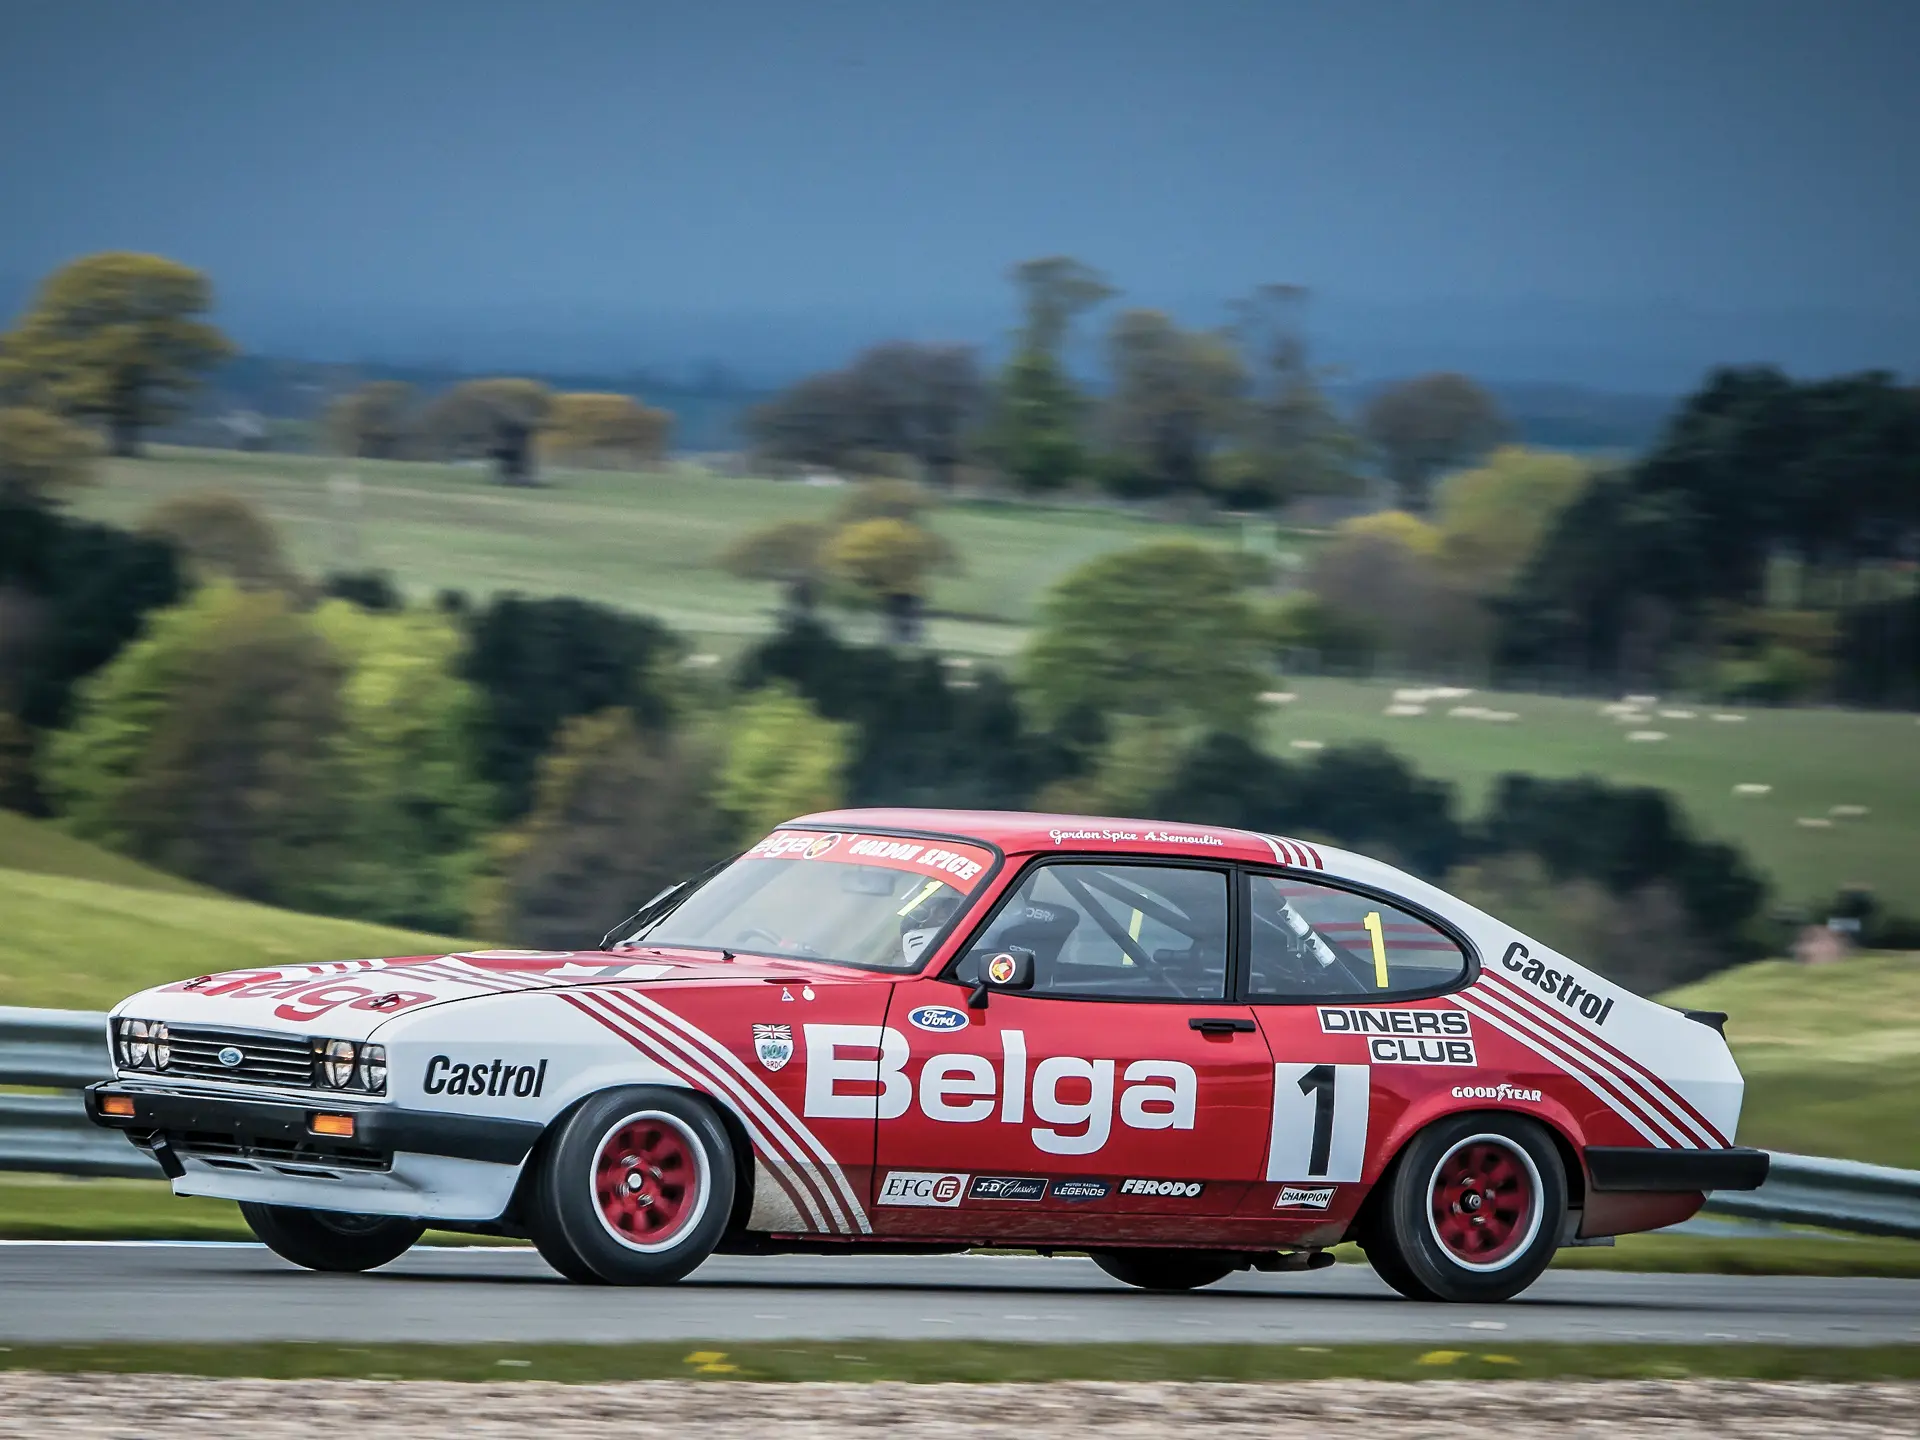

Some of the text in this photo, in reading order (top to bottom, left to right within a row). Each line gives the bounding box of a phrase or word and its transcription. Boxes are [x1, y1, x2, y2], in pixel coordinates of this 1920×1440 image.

[748, 832, 815, 857] elga
[1049, 829, 1223, 846] Gordon Spice A.Semoulin
[916, 848, 982, 880] SPICE
[1363, 911, 1388, 988] 1
[1502, 941, 1615, 1026] Castrol
[921, 1010, 957, 1028] Ford
[1320, 1009, 1468, 1035] DINERS
[1371, 1039, 1473, 1063] CLUB
[424, 1055, 548, 1097] Castrol
[803, 1023, 1198, 1155] Belga
[1297, 1065, 1336, 1176] 1
[886, 1179, 932, 1197] EFG
[1054, 1187, 1105, 1197] LEGENDS
[1120, 1179, 1201, 1197] FERODO
[1281, 1191, 1330, 1202] CHAMPION
